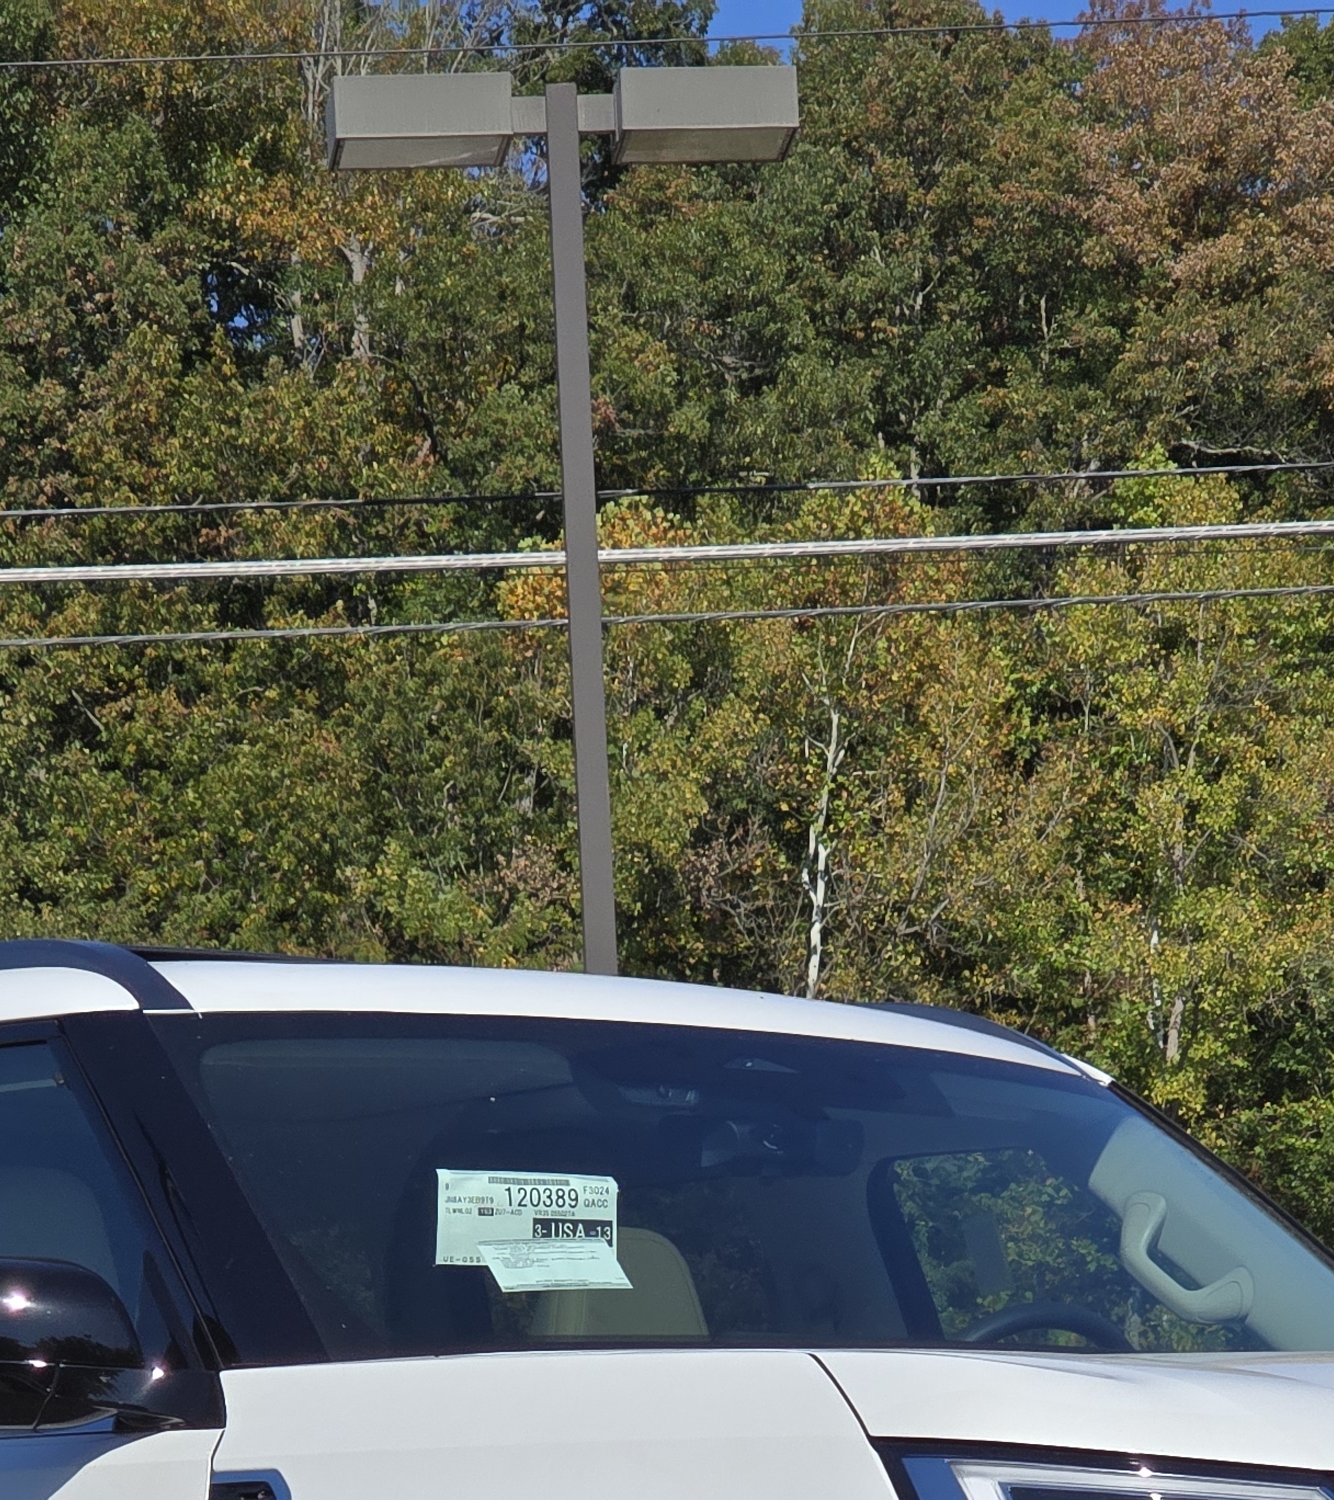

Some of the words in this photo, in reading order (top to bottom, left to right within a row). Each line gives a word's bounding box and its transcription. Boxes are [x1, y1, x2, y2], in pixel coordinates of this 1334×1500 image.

[504, 1186, 579, 1209] 120389
[582, 1185, 610, 1196] F3024
[583, 1198, 609, 1208] QACC
[551, 1222, 586, 1239] USA
